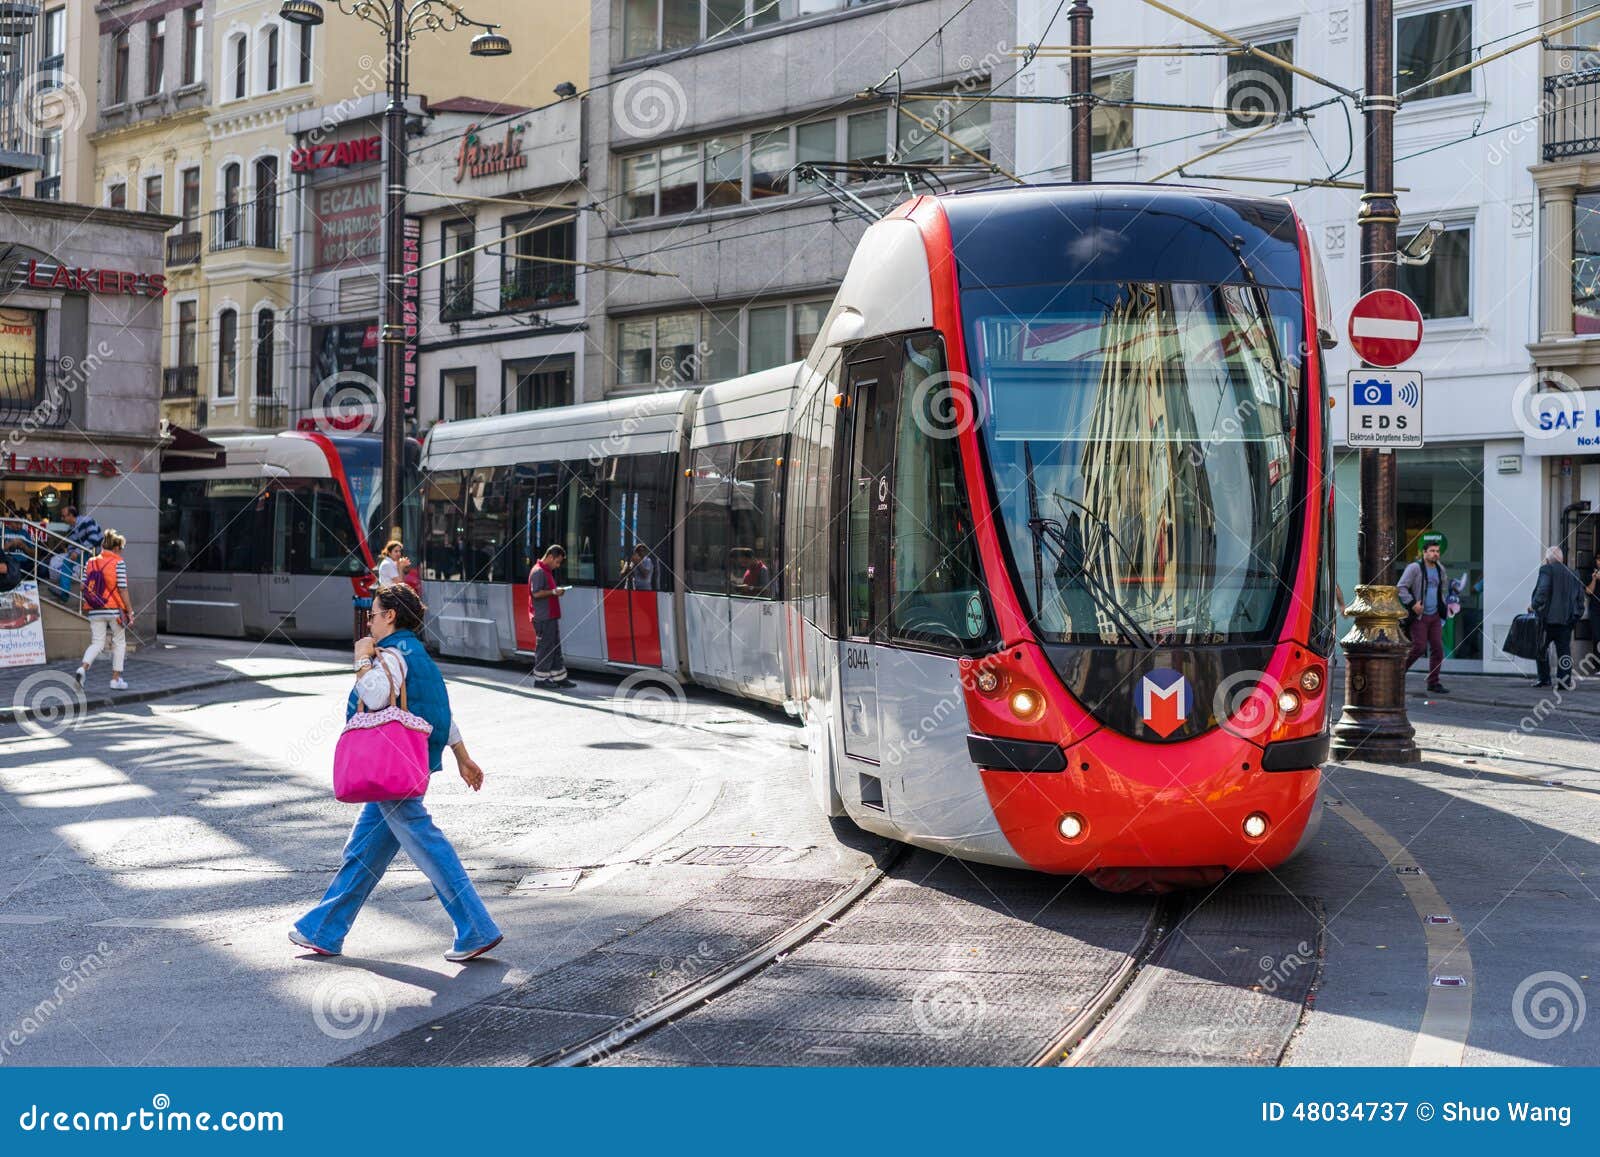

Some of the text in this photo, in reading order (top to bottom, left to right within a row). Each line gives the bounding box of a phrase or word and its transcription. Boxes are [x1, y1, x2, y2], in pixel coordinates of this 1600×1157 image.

[291, 136, 382, 172] ECZANE
[29, 259, 167, 298] LAKER'S
[1540, 411, 1584, 430] SAF
[10, 452, 121, 477] LAKER'S
[847, 647, 870, 670] 804A
